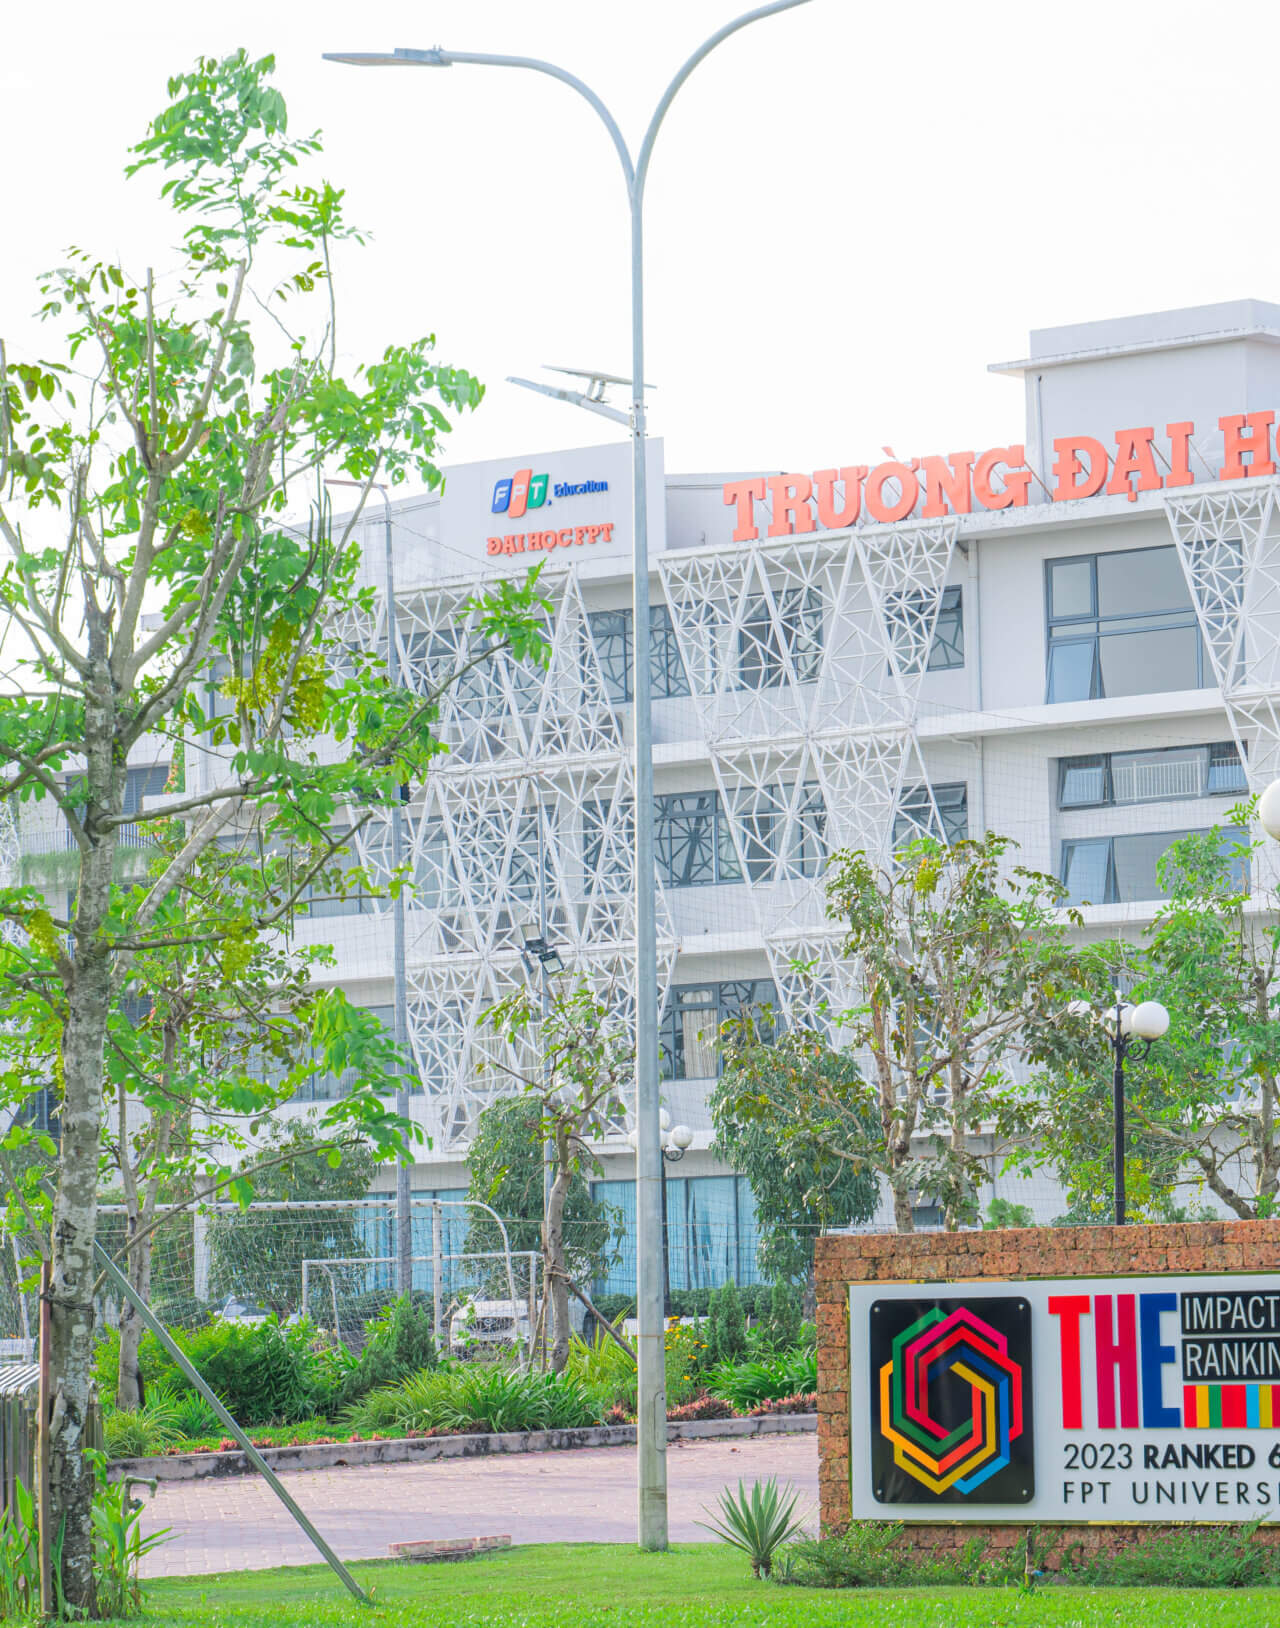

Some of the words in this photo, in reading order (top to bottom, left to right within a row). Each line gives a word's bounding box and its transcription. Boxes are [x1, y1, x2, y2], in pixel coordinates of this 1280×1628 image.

[553, 480, 609, 498] Education
[724, 446, 1032, 541] TRƯỜNG
[1053, 422, 1194, 502] ĐẠI
[487, 534, 525, 557] ĐẠI
[527, 528, 573, 553] HỌC
[574, 523, 614, 545] FPT
[1185, 1296, 1280, 1330] IMPACT
[1048, 1293, 1181, 1430] THE
[1063, 1443, 1133, 1470] 2023
[1143, 1443, 1256, 1470] RANKED
[1063, 1481, 1111, 1504] FPT
